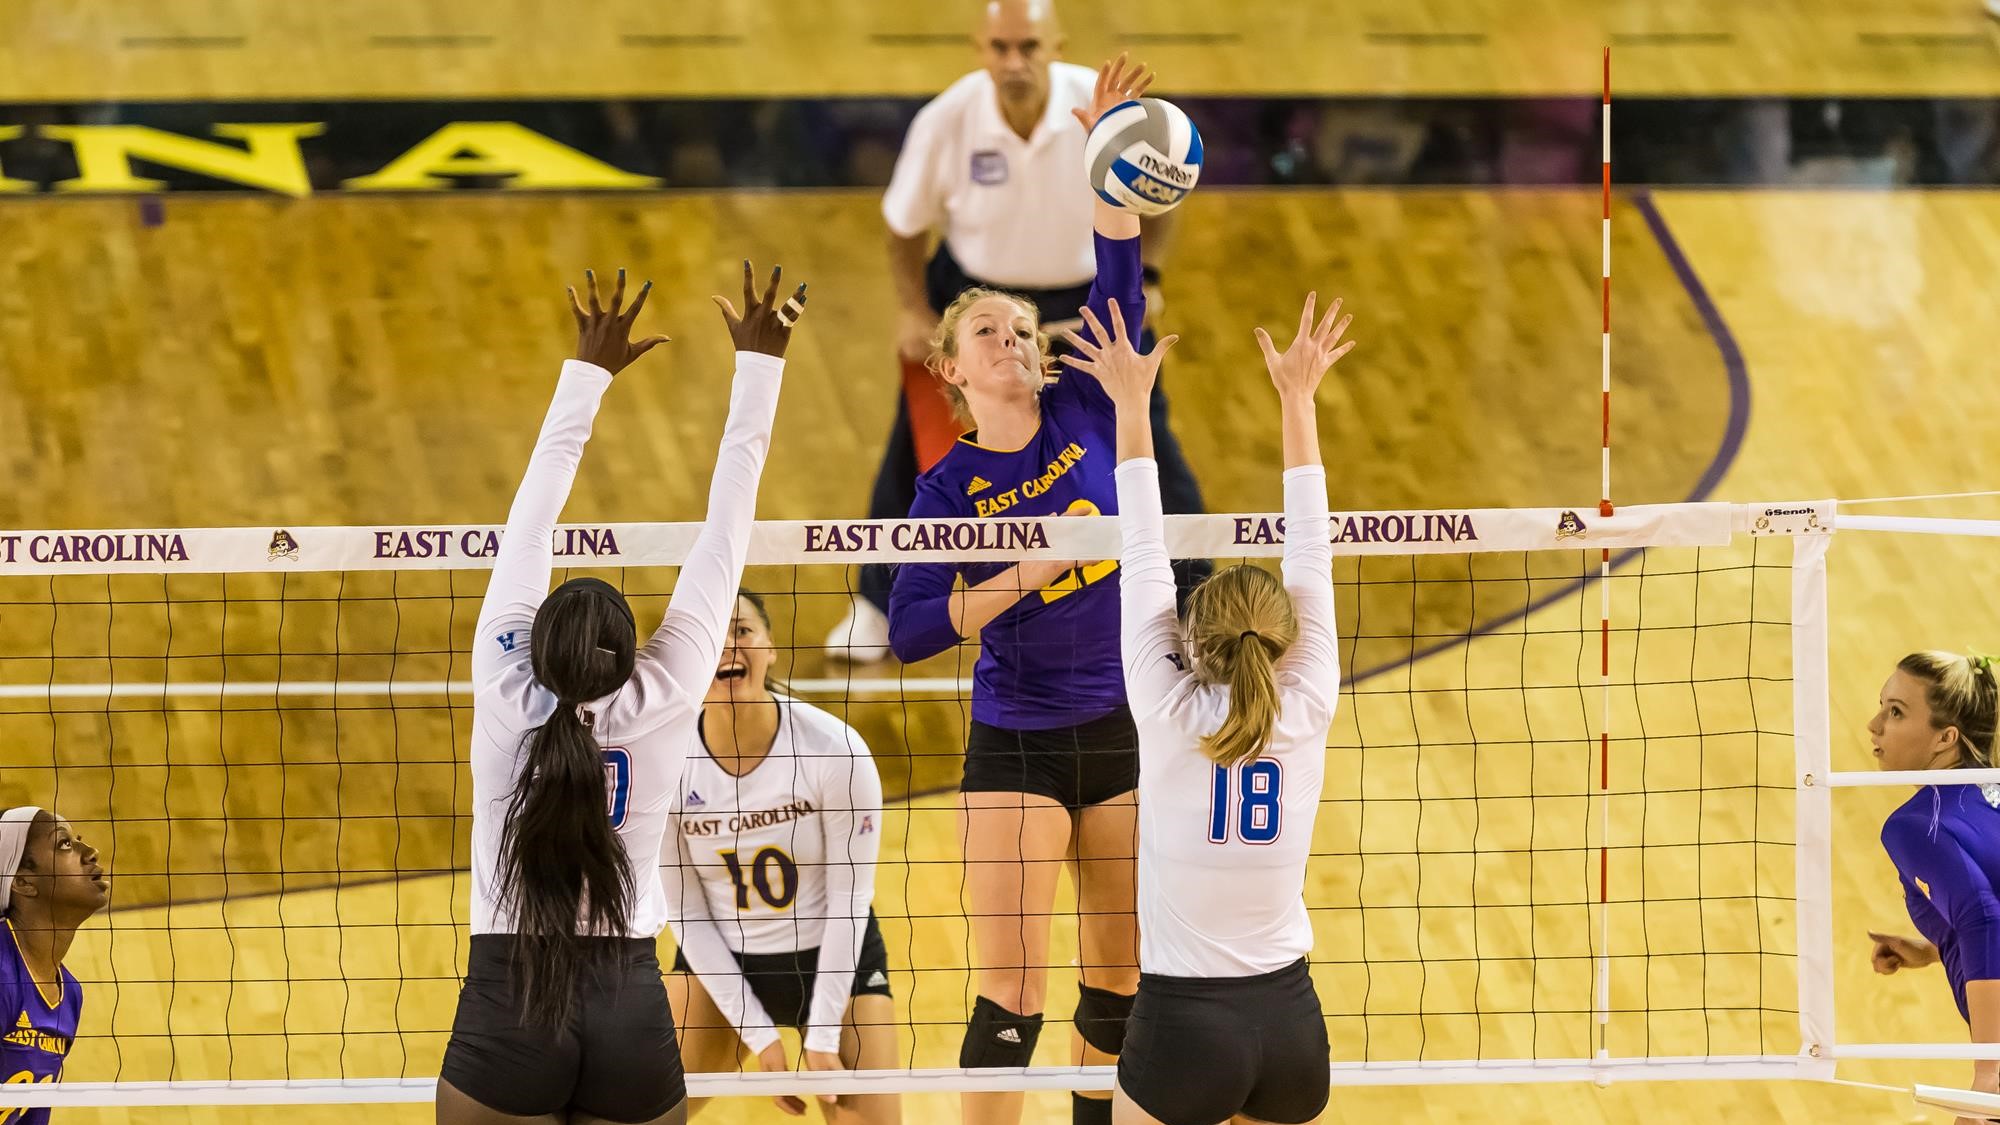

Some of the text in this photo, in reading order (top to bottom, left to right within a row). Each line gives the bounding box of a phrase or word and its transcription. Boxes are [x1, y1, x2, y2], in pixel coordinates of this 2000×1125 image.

[0, 122, 666, 196] NA
[974, 443, 1087, 518] EAST CAROLINA
[0, 534, 190, 564] T CAROLINA
[373, 528, 621, 558] EAST CALINA
[804, 522, 1050, 552] EAST CAROLINA
[1233, 517, 1285, 545] EAS
[683, 800, 816, 836] EAST CAROLINA
[1207, 756, 1284, 846] 18
[717, 845, 799, 912] 10
